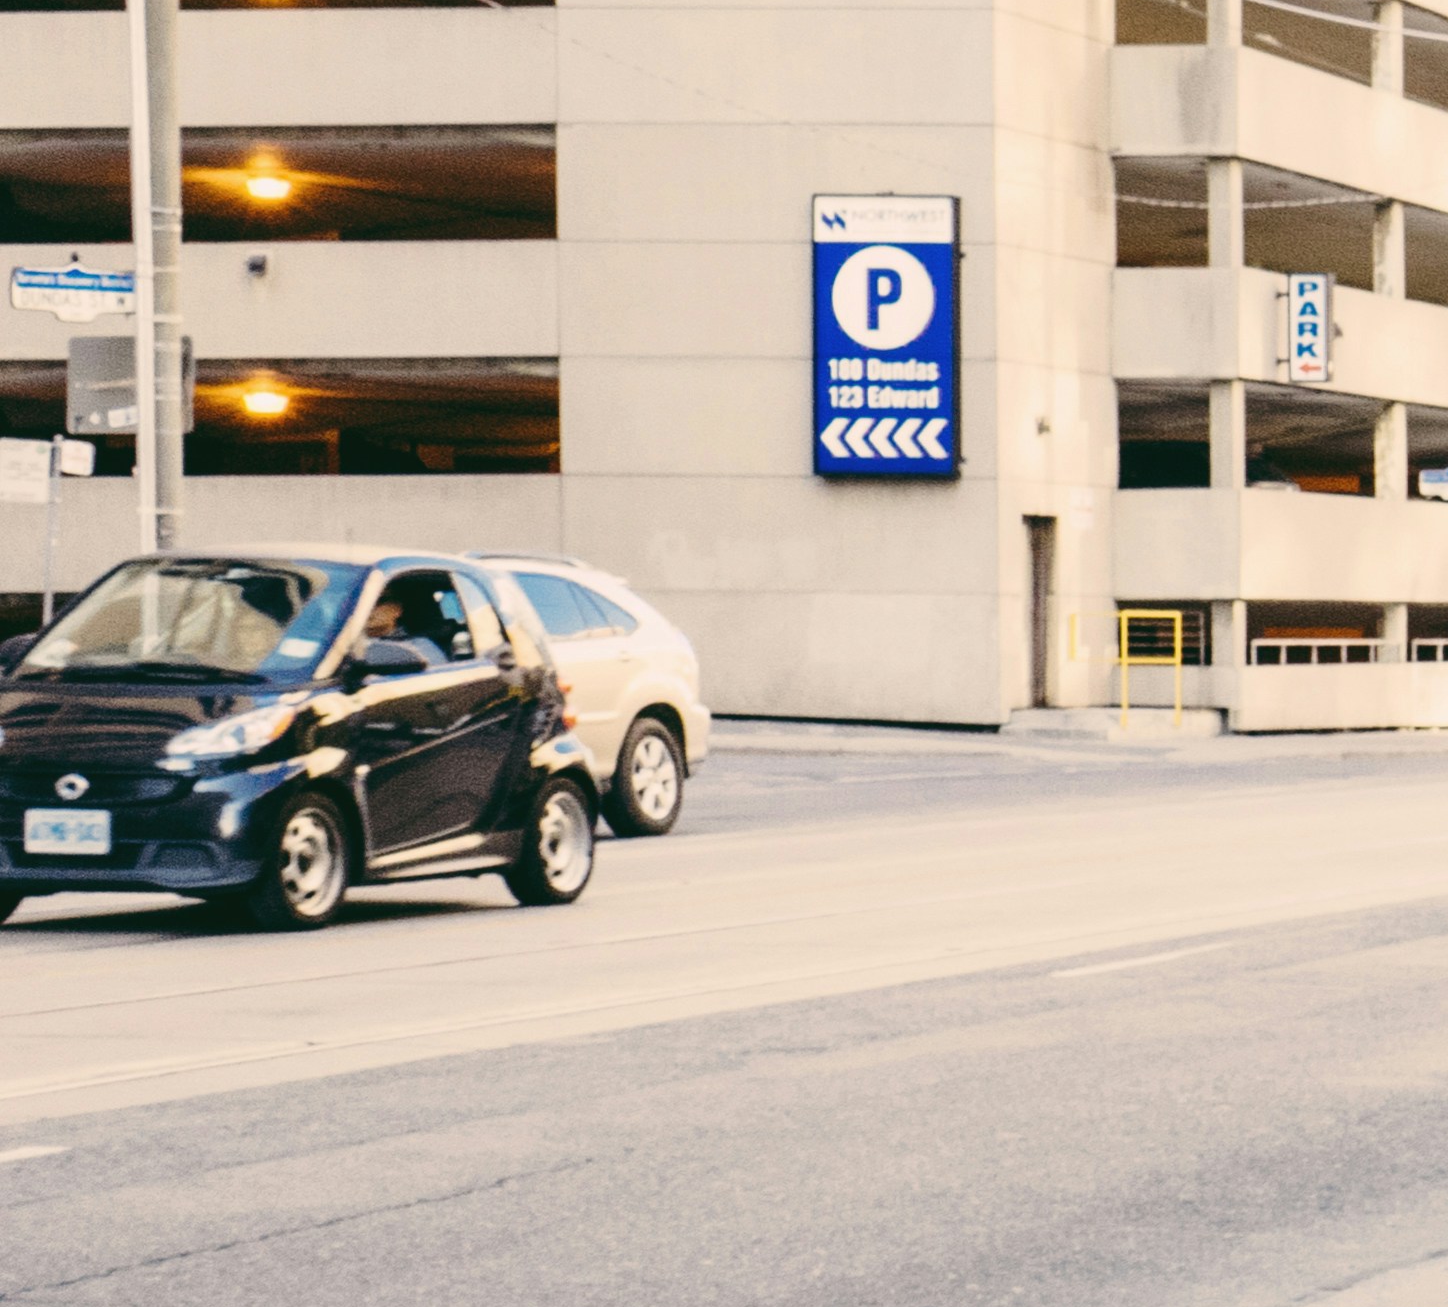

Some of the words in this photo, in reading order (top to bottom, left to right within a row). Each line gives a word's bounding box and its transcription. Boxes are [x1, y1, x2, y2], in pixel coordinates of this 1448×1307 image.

[850, 208, 946, 225] NORTHWEST
[866, 267, 903, 331] P
[1297, 280, 1320, 359] PARK
[866, 357, 940, 382] Dundas
[828, 385, 864, 410] 123
[866, 385, 940, 410] Edward
